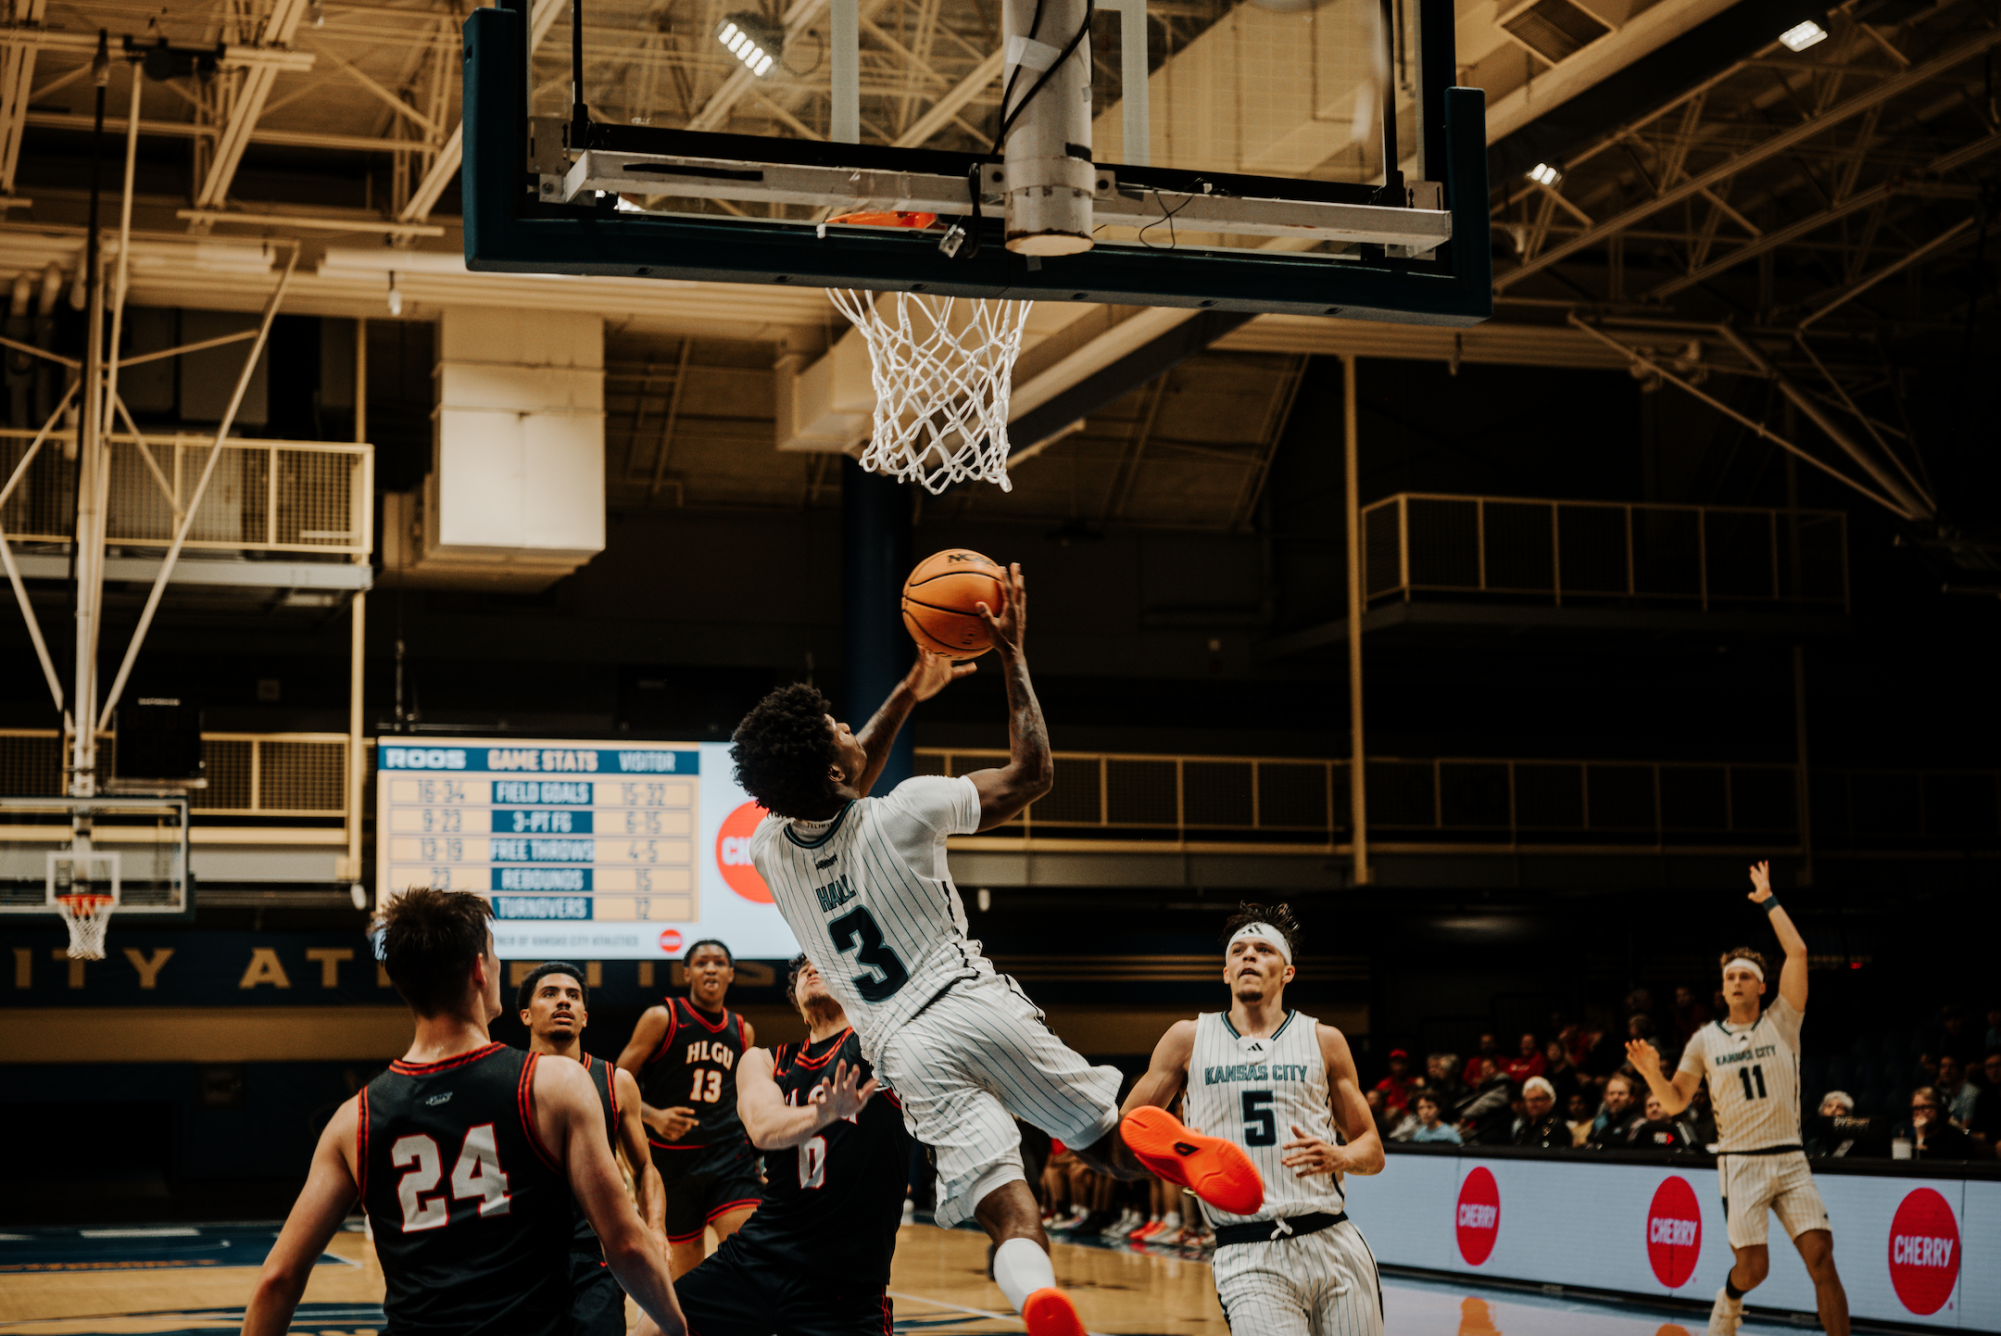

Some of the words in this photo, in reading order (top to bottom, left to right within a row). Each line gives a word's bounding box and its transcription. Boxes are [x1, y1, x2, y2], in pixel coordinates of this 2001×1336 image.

[385, 748, 467, 769] ROOS
[487, 749, 540, 771] GAME
[541, 750, 598, 772] STATS
[618, 751, 676, 772] VISITOR
[417, 779, 465, 803] 16-34
[496, 781, 539, 802] FIELD
[540, 782, 589, 803] GOALS
[423, 809, 462, 832] 9-23
[512, 811, 551, 832] 3-PT
[551, 812, 572, 832] FG
[420, 837, 463, 861] 13-19
[490, 839, 529, 861] FREE
[530, 839, 595, 862] THROWS
[627, 839, 658, 863] 4-5
[430, 867, 450, 890] 23
[501, 868, 584, 891] REBOUNDS
[815, 874, 857, 913] HALL
[498, 896, 587, 919] TURNOVERS
[827, 905, 910, 1004] 3
[685, 1040, 734, 1070] HLGU
[1755, 1045, 1776, 1059] CITY
[689, 1068, 722, 1103] 13
[1205, 1065, 1268, 1085] KANSAS
[1272, 1065, 1307, 1082] CITY
[1739, 1064, 1767, 1100] 11
[1241, 1090, 1277, 1147] 5
[798, 1135, 827, 1189] 0
[390, 1122, 512, 1233] 24
[1458, 1203, 1498, 1229] CHERRY
[1650, 1217, 1698, 1246] CHERRY
[1894, 1234, 1954, 1268] CHERRY
